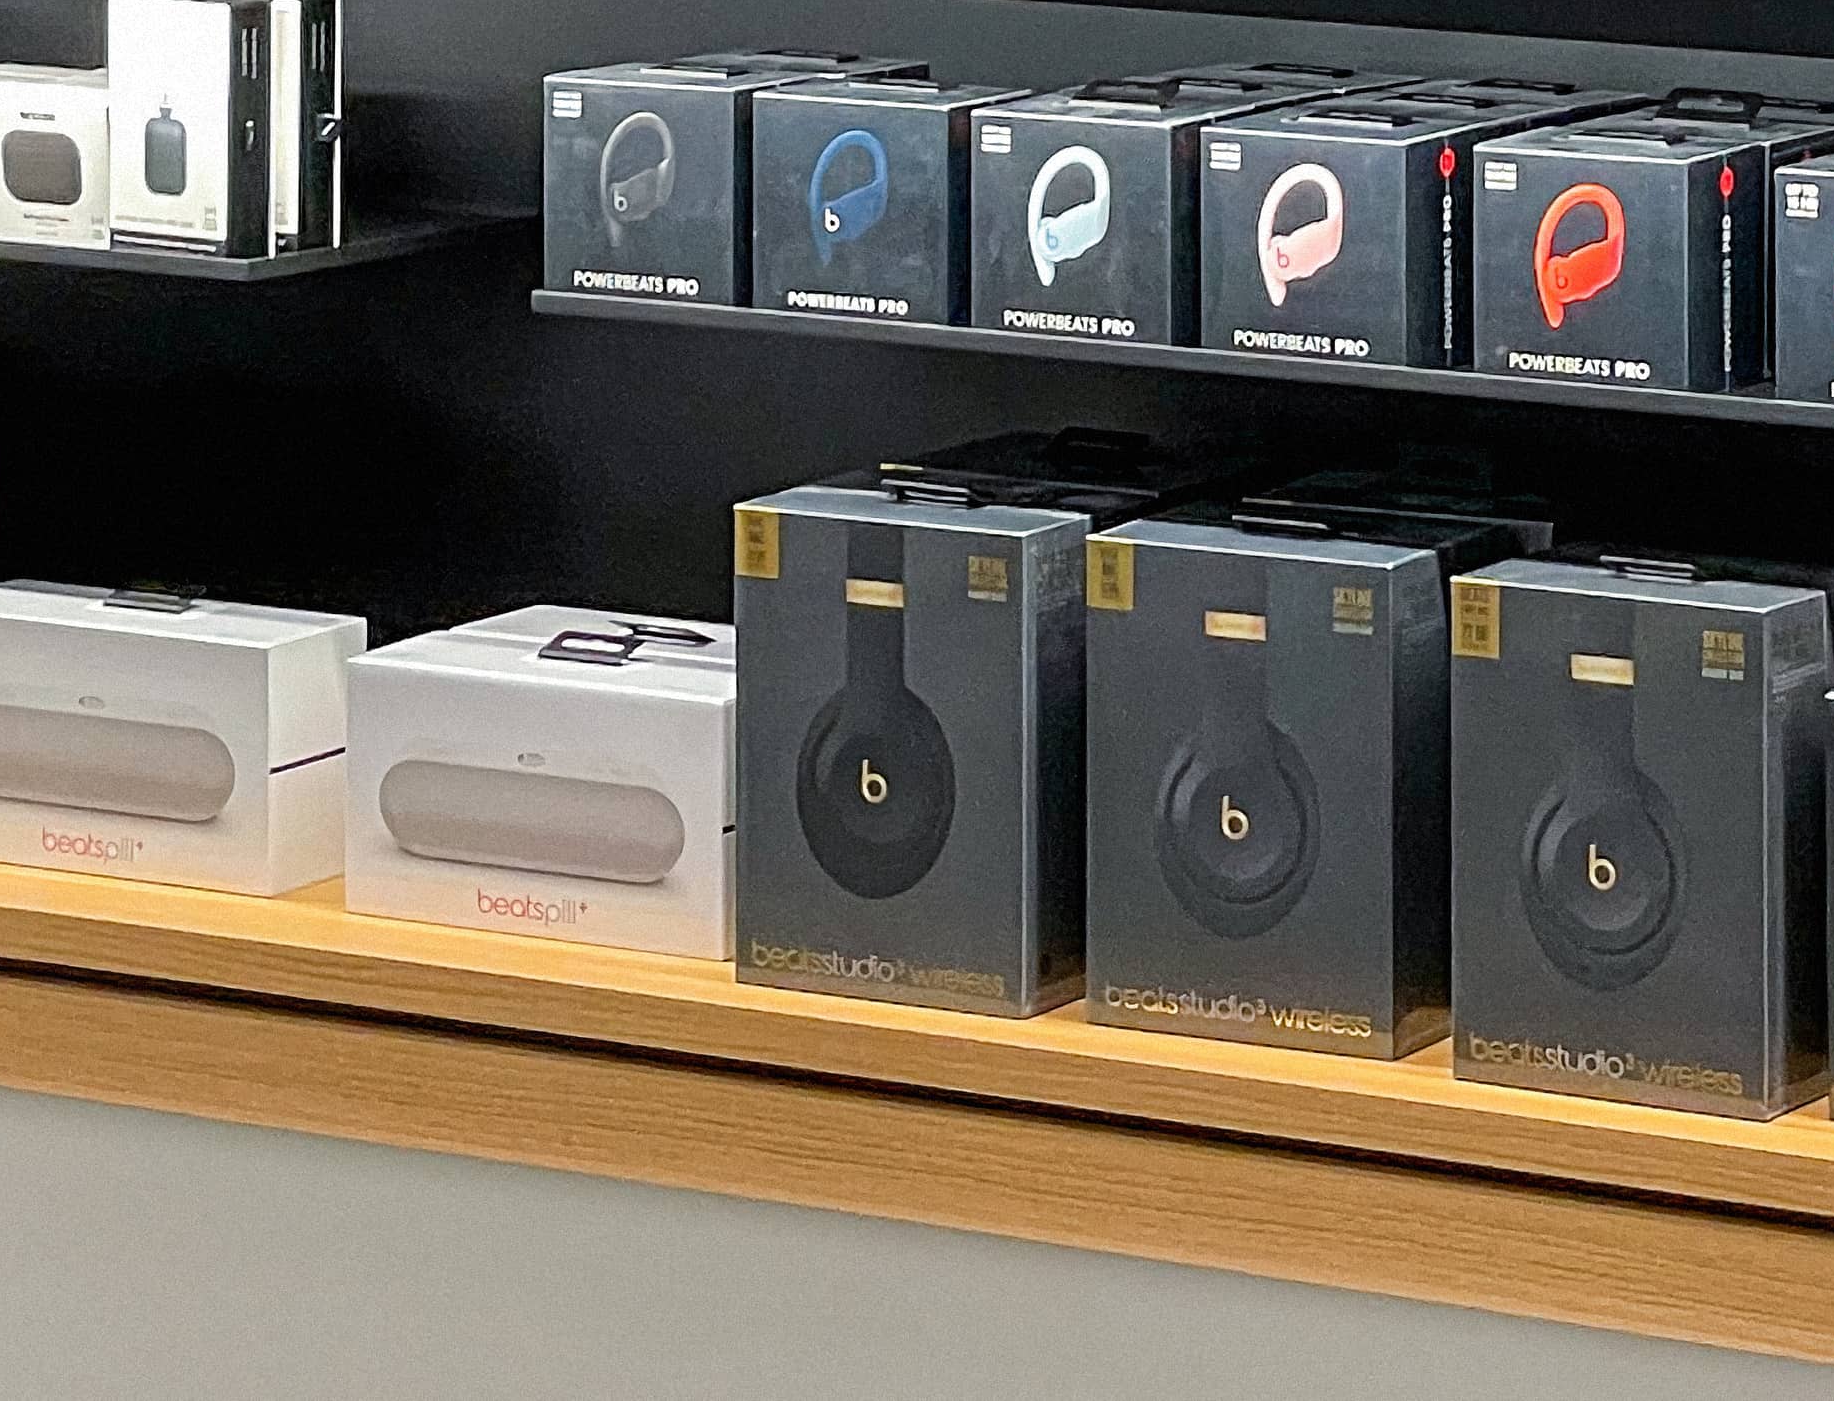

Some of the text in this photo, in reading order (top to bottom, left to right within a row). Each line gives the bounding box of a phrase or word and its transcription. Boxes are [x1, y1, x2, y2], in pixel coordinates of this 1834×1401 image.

[1003, 309, 1135, 337] POWERBEATS PRO
[1233, 328, 1370, 358] POWERBEATS PRO
[1508, 351, 1651, 381] POWERBEATS PRO
